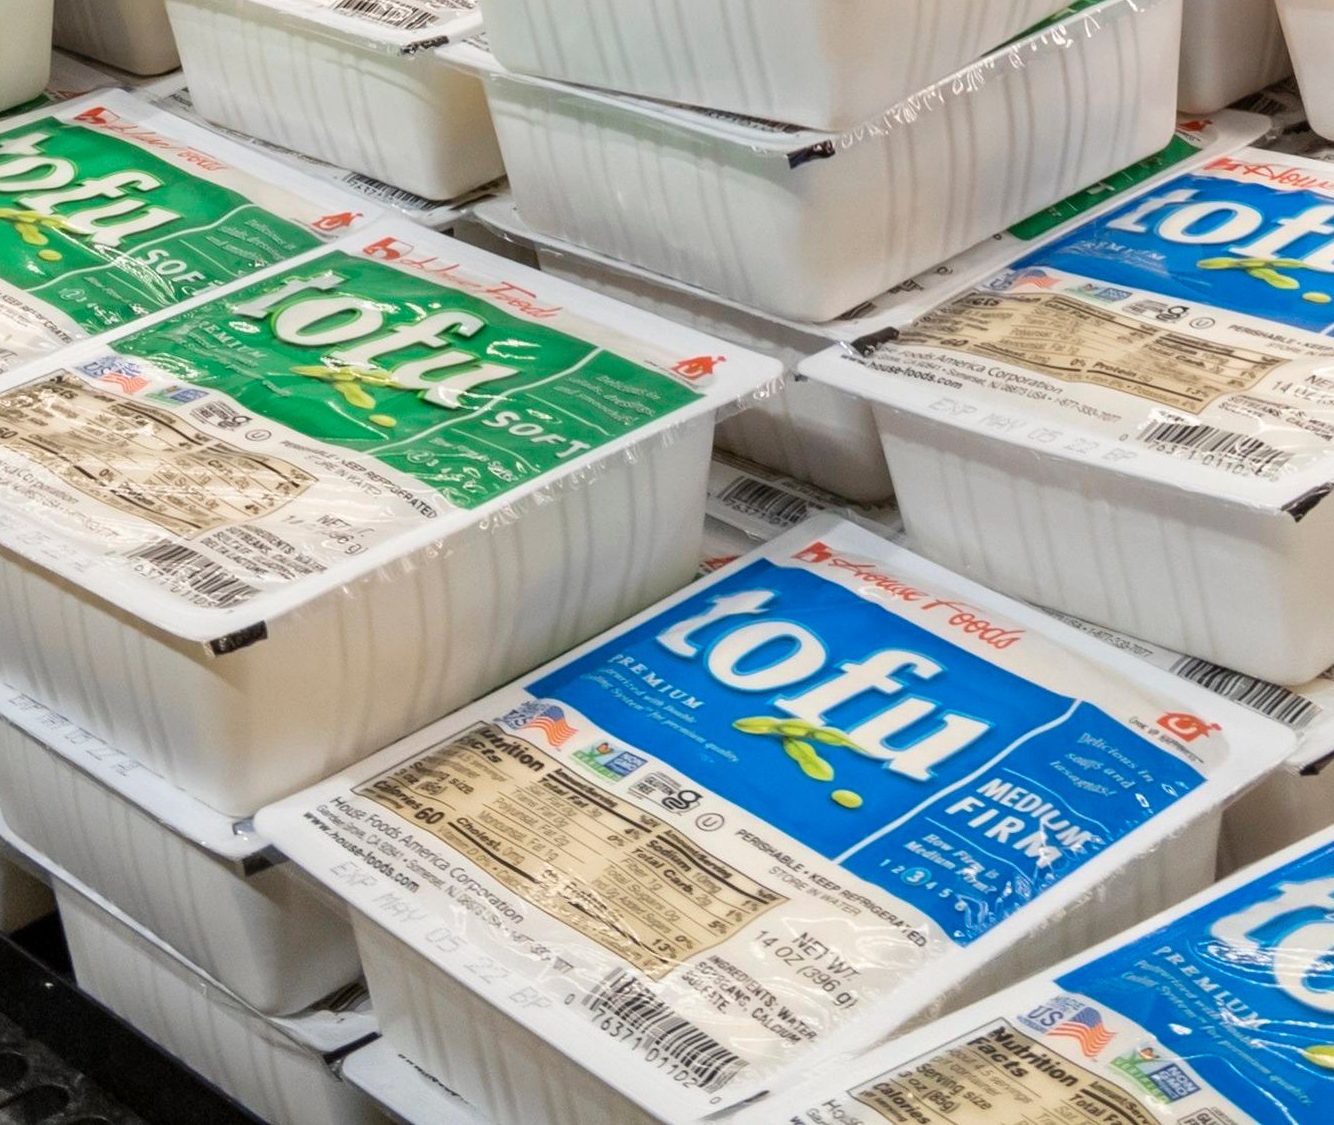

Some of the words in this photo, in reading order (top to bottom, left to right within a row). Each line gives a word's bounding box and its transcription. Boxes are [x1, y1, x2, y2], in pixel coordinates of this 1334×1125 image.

[232, 270, 522, 410] tofu
[987, 364, 1063, 395] Corporation
[480, 410, 592, 458] SOFT
[827, 554, 920, 602] House
[921, 597, 1026, 652] Foods
[607, 653, 705, 711] PREMIUM
[655, 587, 995, 786] tofu
[413, 805, 446, 826] 60
[538, 776, 565, 797] Total
[566, 788, 589, 809] Fat
[974, 777, 1098, 852] MEDIUM
[302, 809, 421, 894] www.house-foods.com
[455, 815, 504, 853] Cholest.
[645, 839, 692, 873] Sodium
[944, 795, 1063, 868] FIRM
[329, 795, 363, 823] House
[367, 814, 401, 840] Foods
[398, 833, 452, 871] America
[449, 864, 524, 925] Corporation
[329, 860, 378, 889] EXP
[631, 845, 664, 873] Total
[662, 869, 695, 895] Carb.
[734, 828, 804, 871] PERISHABLE
[809, 871, 844, 896] KEEP
[837, 887, 928, 949] REFRIGERATED
[767, 865, 808, 890] STORE
[805, 885, 823, 900] IN
[819, 892, 863, 918] WATER
[708, 954, 779, 1009] INGREDIENTS:
[755, 928, 774, 950] 14
[773, 943, 800, 967] OZ
[795, 956, 839, 996] (396
[832, 986, 859, 1010] g)
[792, 931, 833, 960] NET
[824, 955, 864, 982] WT.
[1153, 945, 1265, 1031] PREMIUM
[591, 1006, 642, 1053] 76371
[645, 1047, 701, 1091] 01102
[750, 1007, 802, 1044] CALCIUM
[970, 1036, 1029, 1082] Facts
[991, 1022, 1081, 1088] Nutrition
[915, 1062, 965, 1099] Serving
[959, 1086, 994, 1114] size
